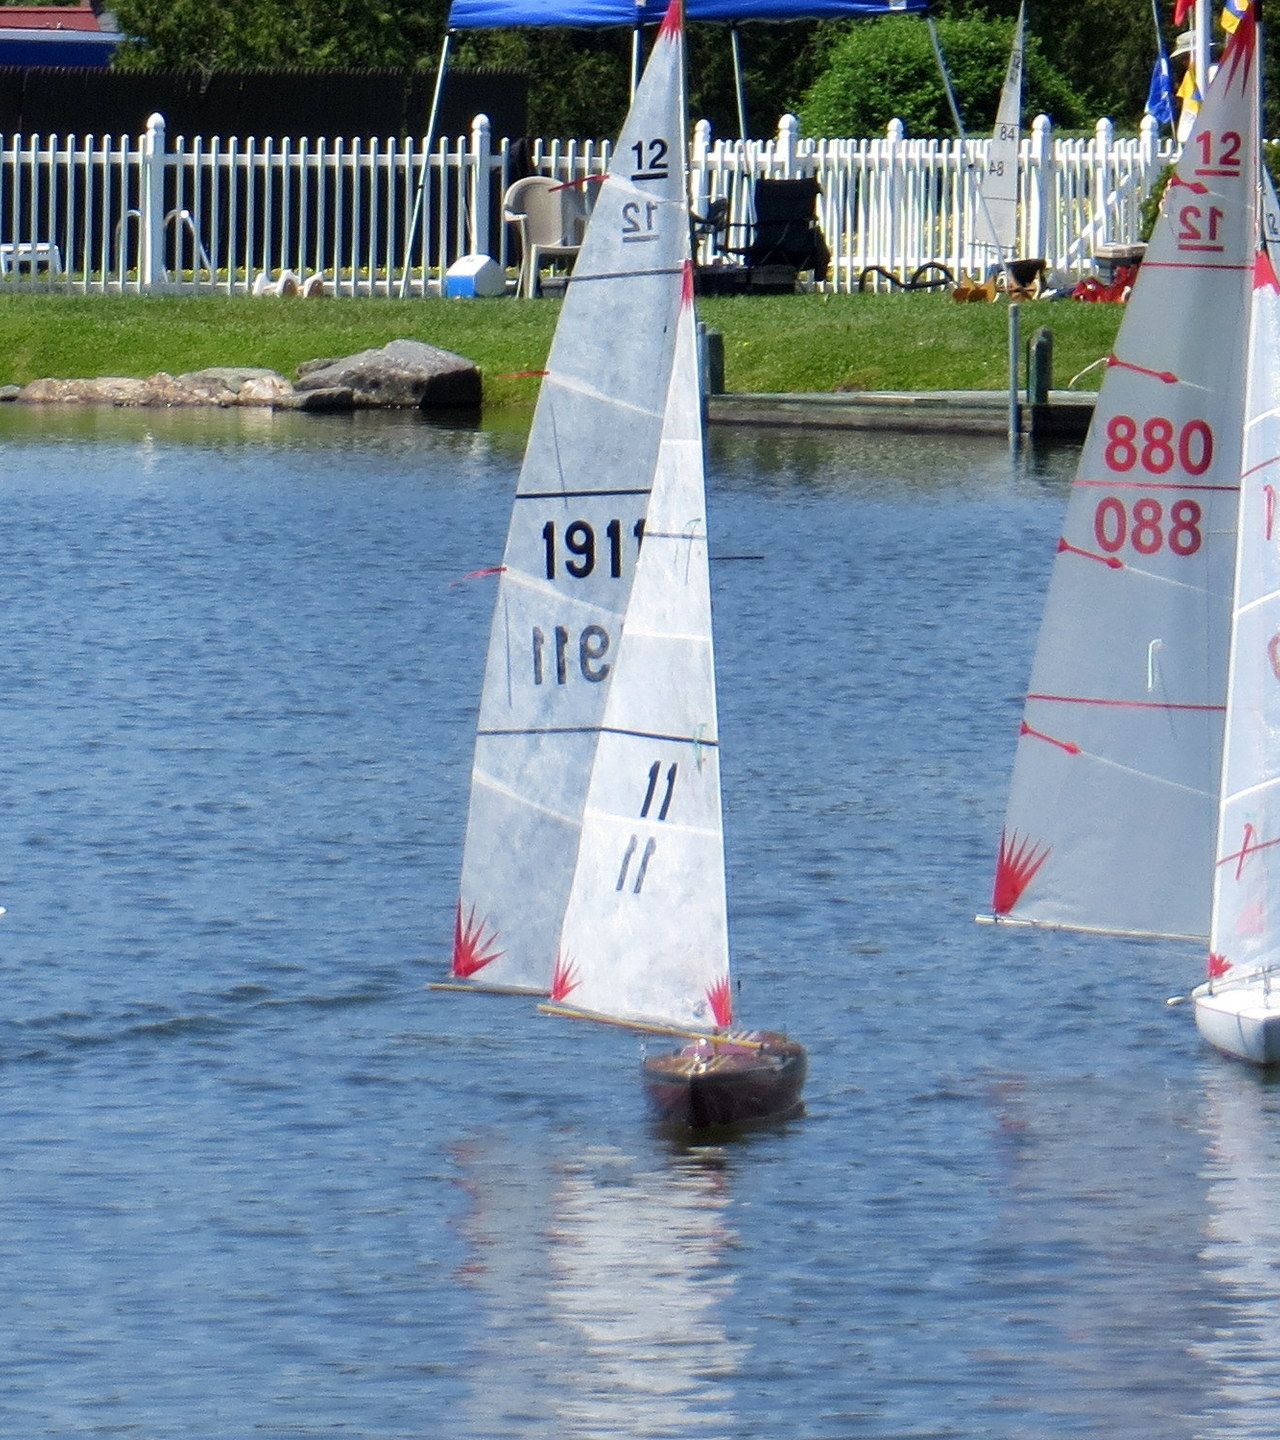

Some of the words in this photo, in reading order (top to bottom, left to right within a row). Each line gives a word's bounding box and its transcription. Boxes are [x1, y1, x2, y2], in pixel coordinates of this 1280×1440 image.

[1000, 124, 1016, 141] 84
[1196, 130, 1241, 166] 12
[631, 138, 669, 170] 12
[1104, 415, 1213, 476] 880
[640, 760, 678, 821] 11
